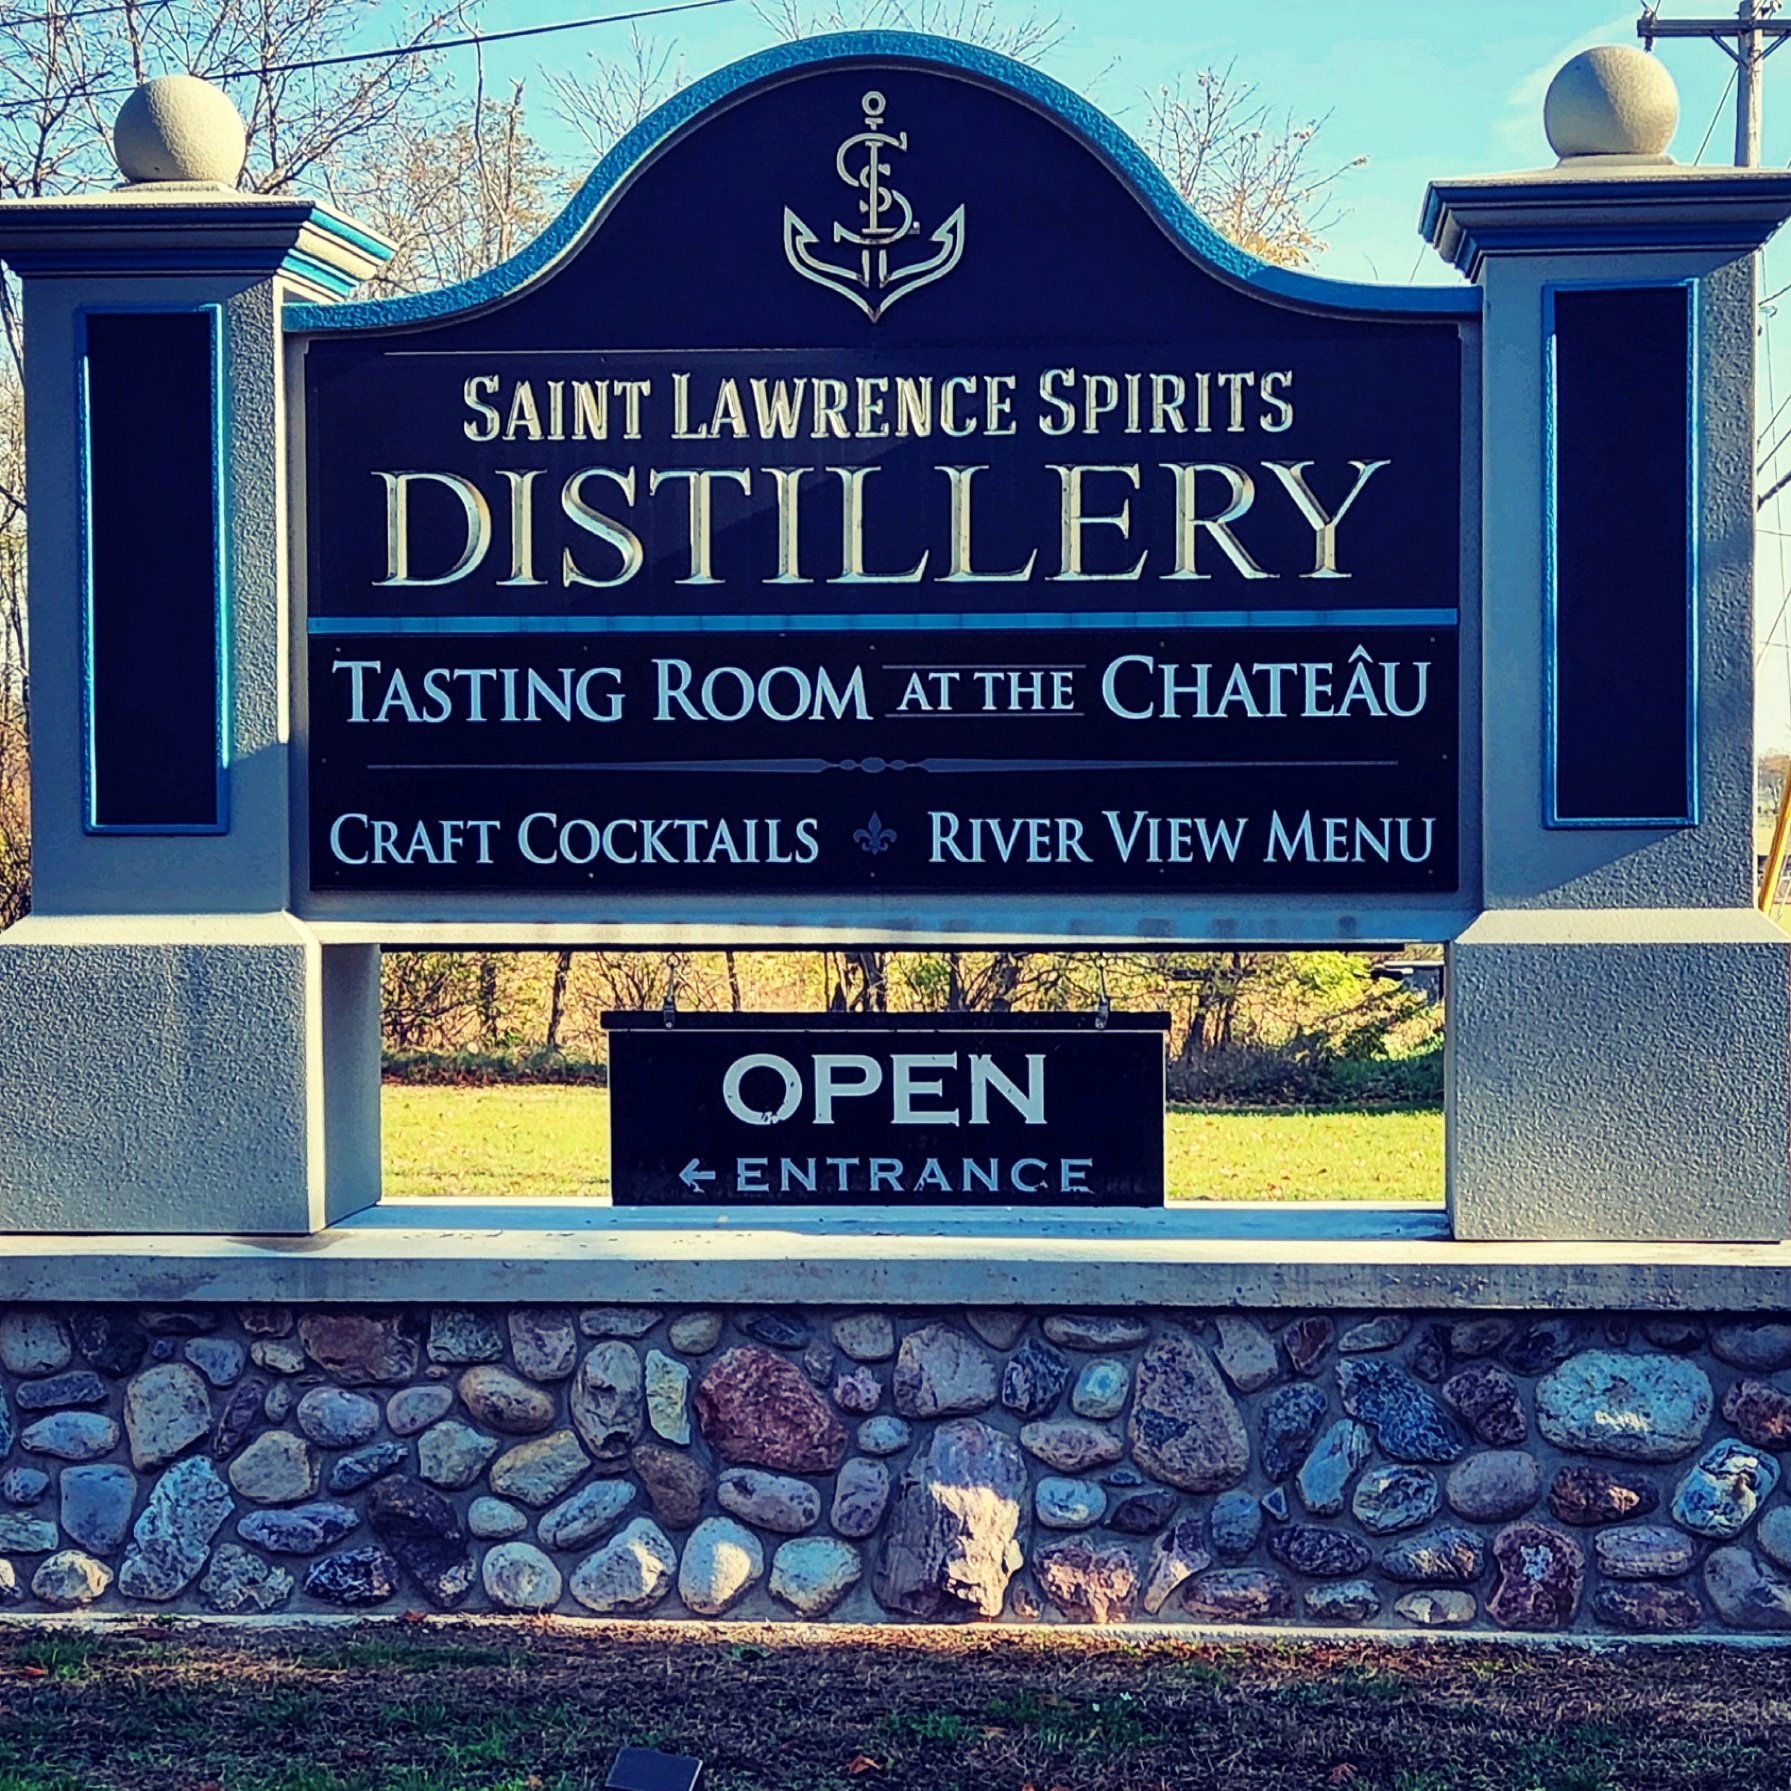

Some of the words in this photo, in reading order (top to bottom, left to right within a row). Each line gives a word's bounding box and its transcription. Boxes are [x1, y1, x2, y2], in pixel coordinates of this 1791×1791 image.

[463, 374, 651, 442] SAINT
[670, 372, 1017, 440] LAWRENCE
[1038, 367, 1294, 436] SPIRITS
[370, 459, 1392, 588] DISTILLERY
[331, 659, 626, 723] TASTING
[651, 658, 874, 722] ROOM
[896, 671, 961, 711] AT
[973, 671, 1075, 711] THE
[1101, 643, 1432, 720] CHATEÂU
[330, 812, 501, 865] CRAFT
[517, 812, 819, 865] COCKTAILS
[927, 811, 1094, 863] RIVER
[1101, 810, 1249, 863] VIEW
[1263, 809, 1436, 863] MENU
[722, 1050, 1048, 1128] OPEN
[736, 1157, 1093, 1194] ENTRANCE
